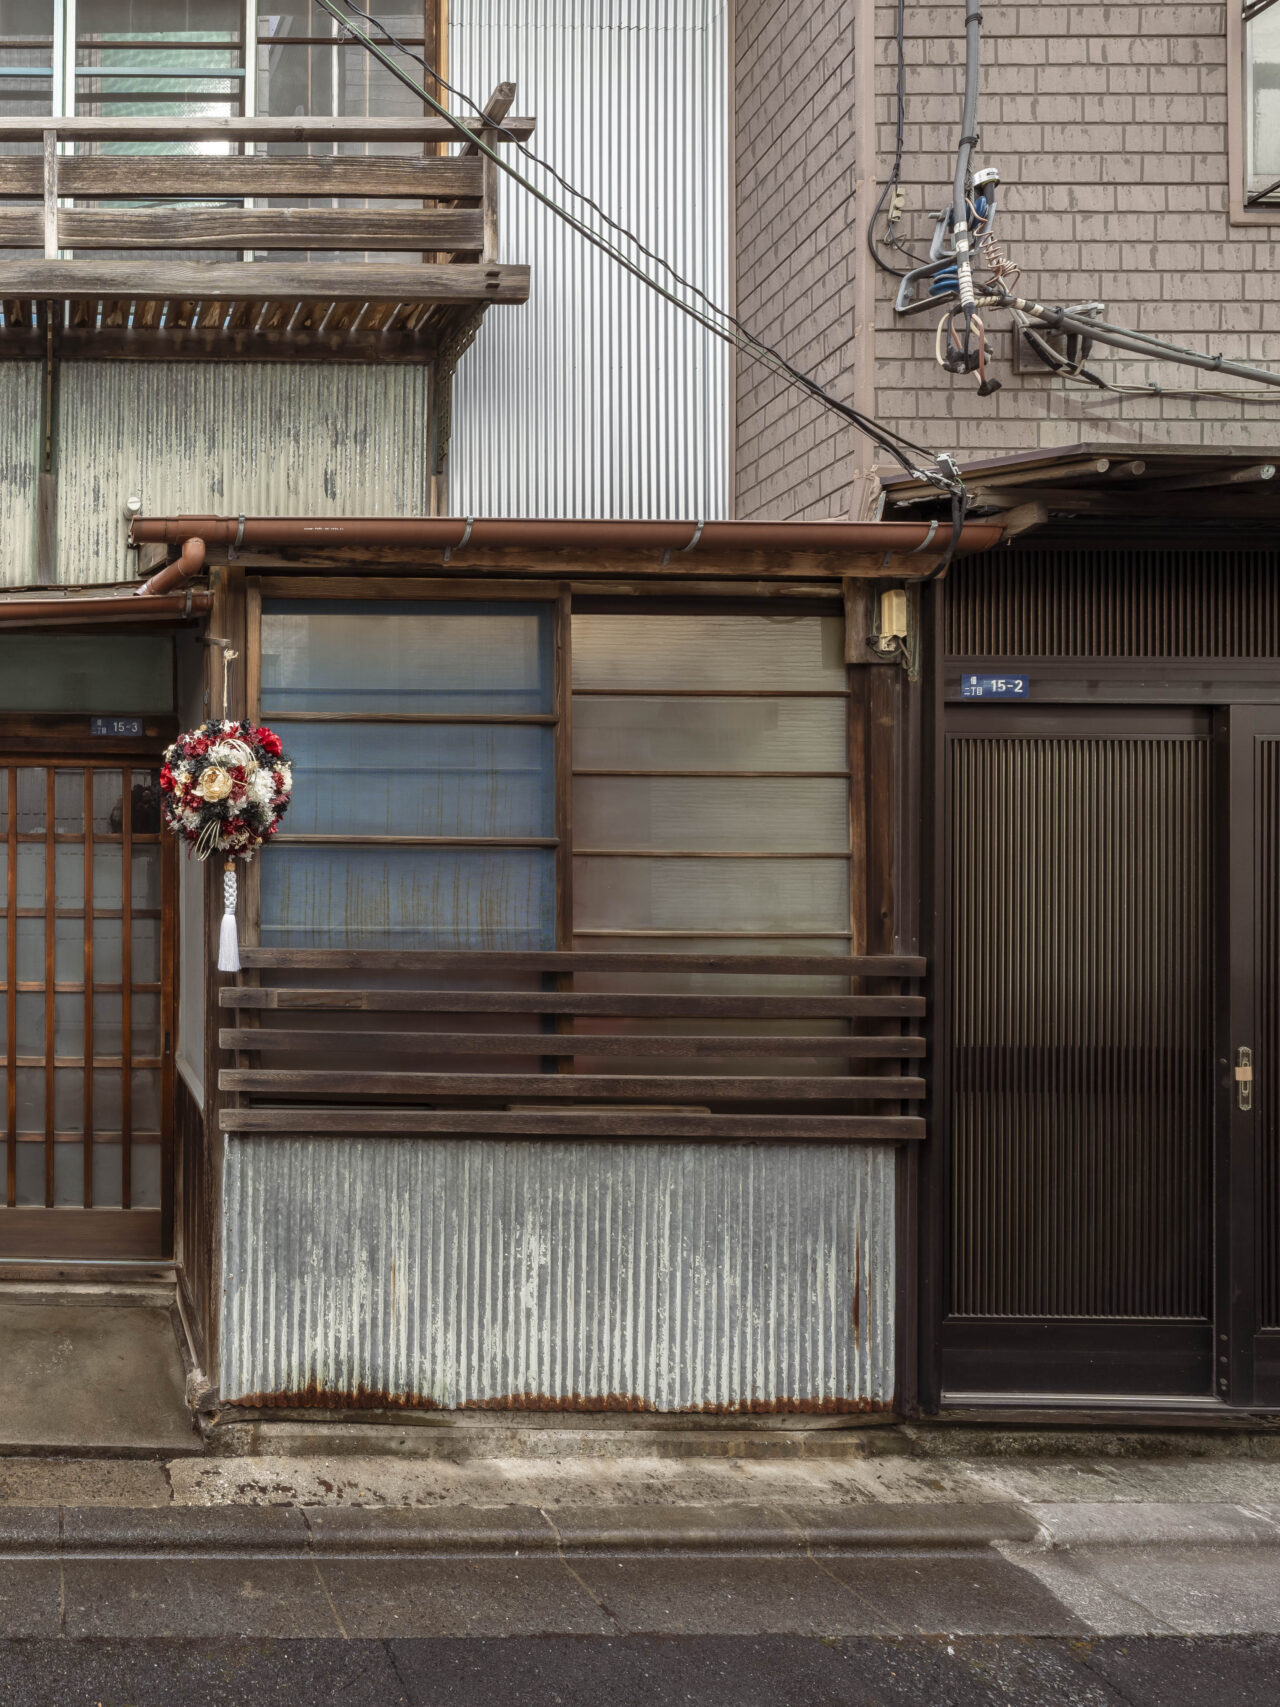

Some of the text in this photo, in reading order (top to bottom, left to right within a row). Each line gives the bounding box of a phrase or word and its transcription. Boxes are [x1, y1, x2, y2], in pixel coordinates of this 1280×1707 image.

[964, 686, 983, 696] 二丁目
[991, 680, 1023, 692] 15-2
[113, 722, 138, 732] 15-3
